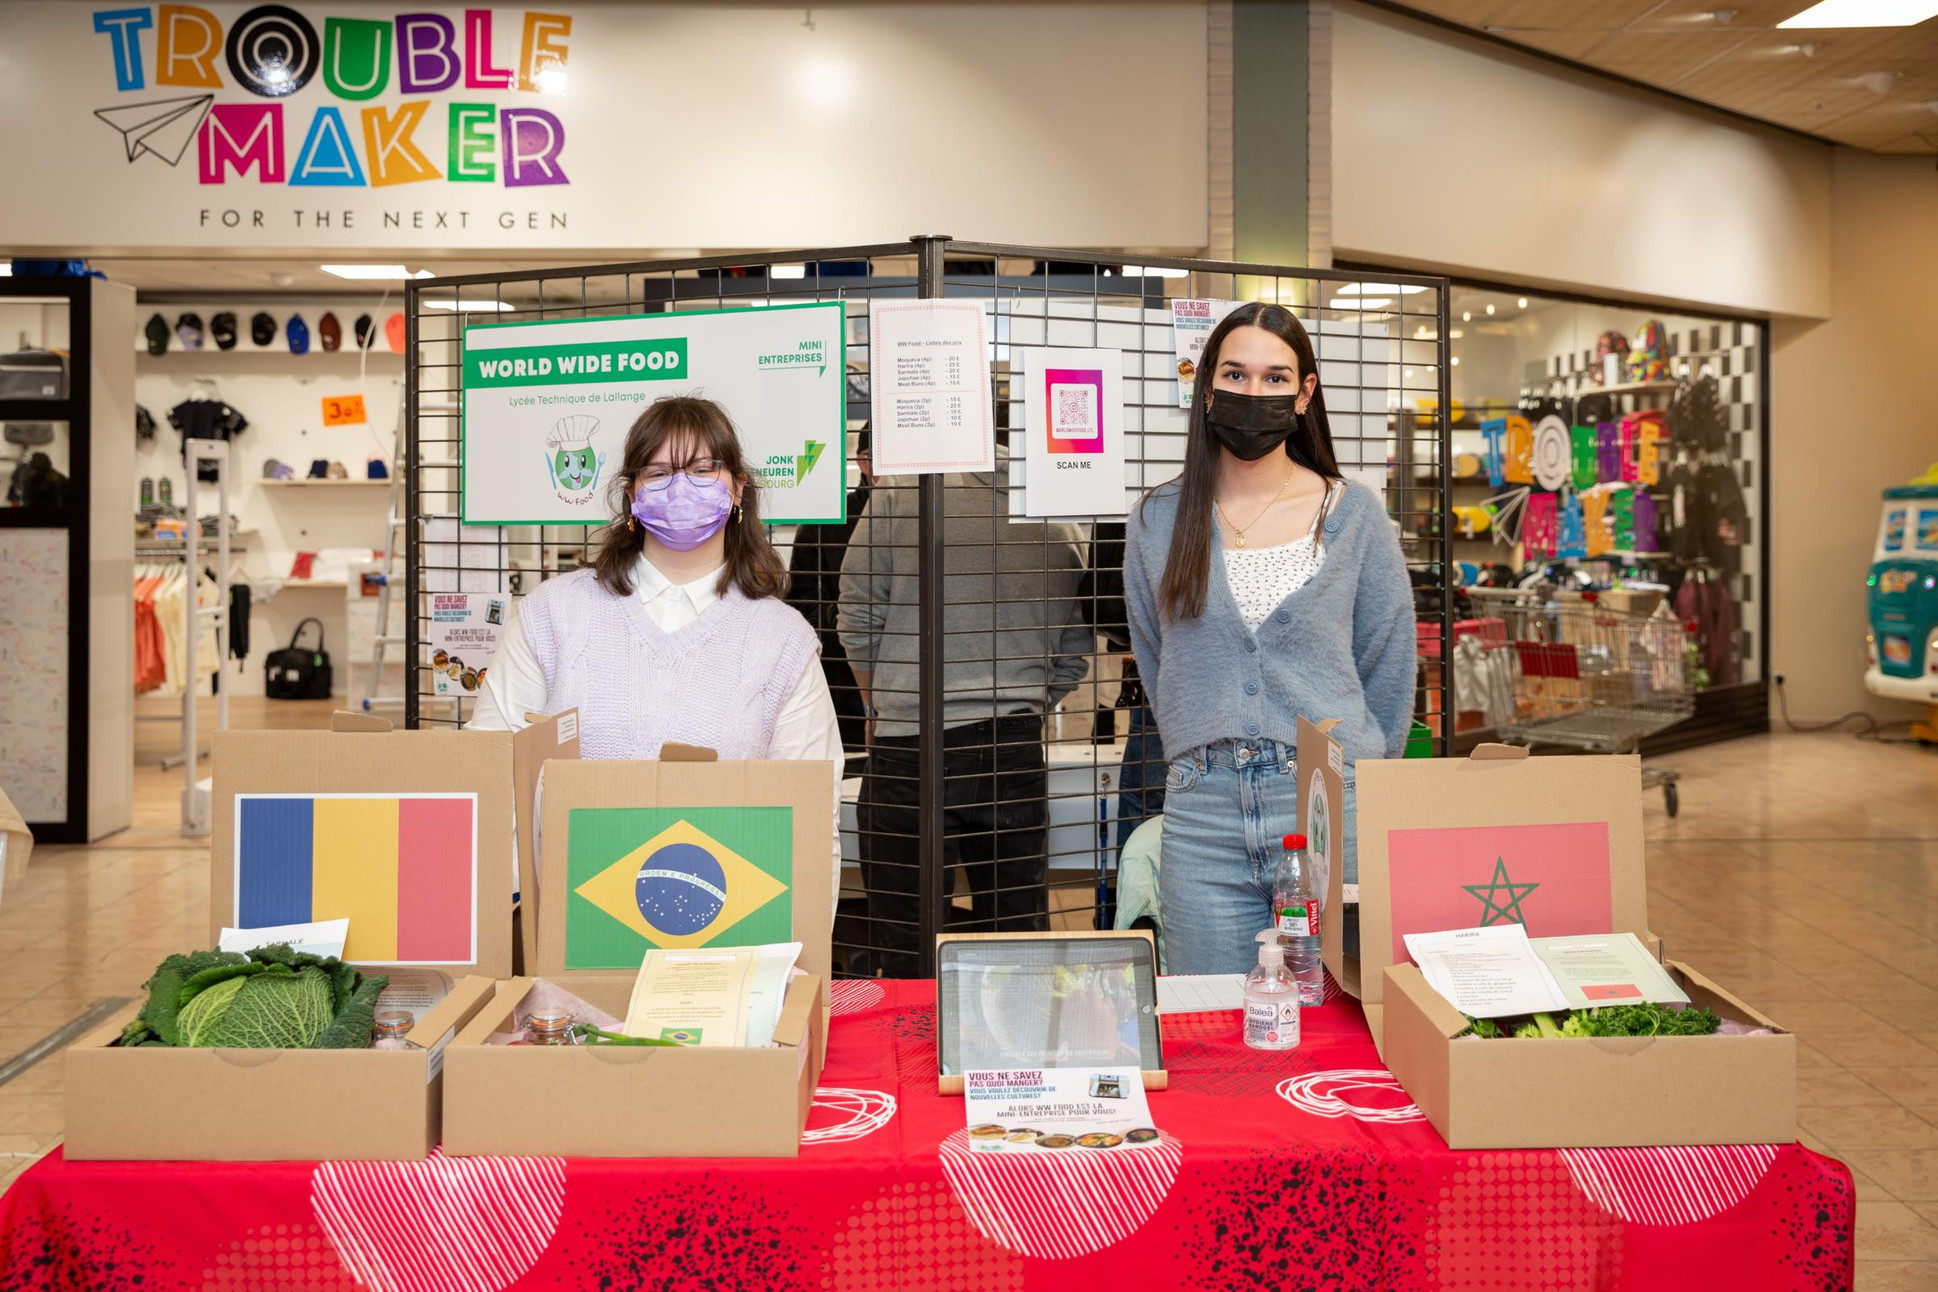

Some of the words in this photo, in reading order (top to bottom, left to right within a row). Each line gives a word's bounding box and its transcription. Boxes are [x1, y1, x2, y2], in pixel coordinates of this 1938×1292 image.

[93, 4, 573, 101] TROUBLE
[198, 100, 571, 188] MAKER
[199, 209, 266, 229] FOR
[294, 210, 354, 229] THE
[384, 211, 470, 229] NEXT
[498, 211, 568, 230] GEN
[799, 340, 822, 350] MINI
[479, 358, 552, 378] WORLD
[557, 354, 612, 374] WIDE
[618, 351, 679, 371] FOOD
[758, 353, 822, 365] ENTREPRISES
[509, 396, 535, 407] Lycée
[538, 393, 585, 405] Technique
[588, 393, 600, 403] de
[603, 391, 646, 402] Lallange
[1480, 413, 1660, 491] TROUBLE
[766, 455, 794, 465] JONK
[1056, 461, 1079, 470] SCAN
[1080, 461, 1092, 469] ME
[1310, 902, 1318, 927] Vittel
[1249, 1006, 1273, 1017] Balea
[969, 1073, 994, 1081] VOUS
[998, 1072, 1010, 1080] NE
[1014, 1071, 1042, 1080] SAVEZ
[1007, 1079, 1043, 1087] MANGER?
